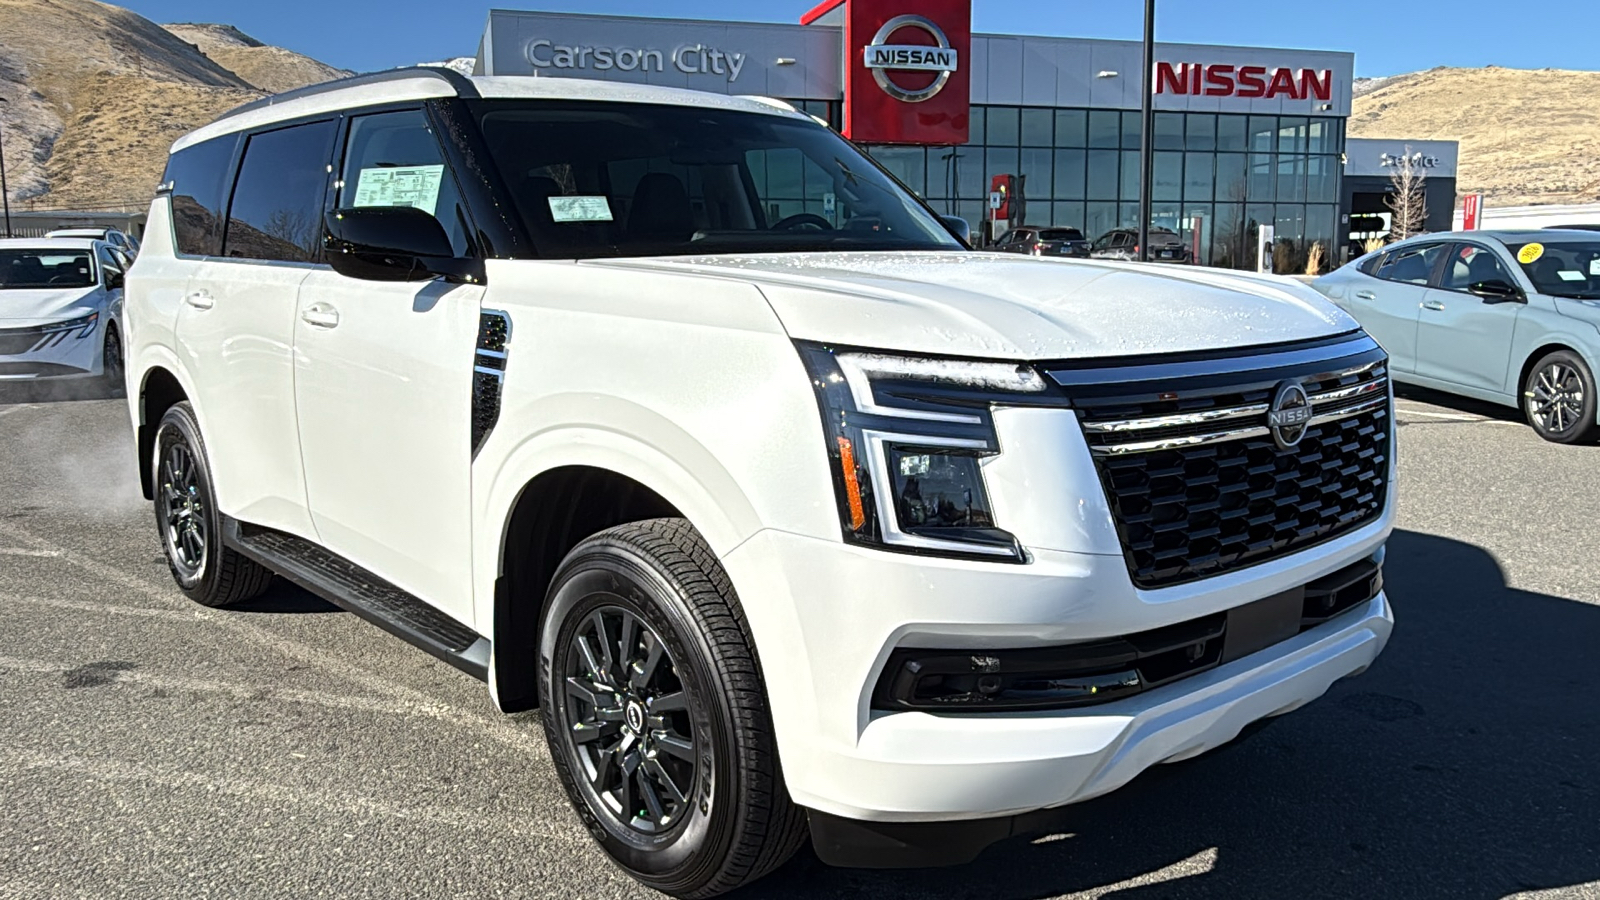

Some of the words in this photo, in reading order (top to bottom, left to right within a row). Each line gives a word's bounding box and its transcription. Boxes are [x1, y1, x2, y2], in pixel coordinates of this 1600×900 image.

[524, 39, 664, 73] Carson
[673, 43, 747, 82] City
[874, 49, 951, 67] NISSAN
[1154, 61, 1332, 101] NISSAN
